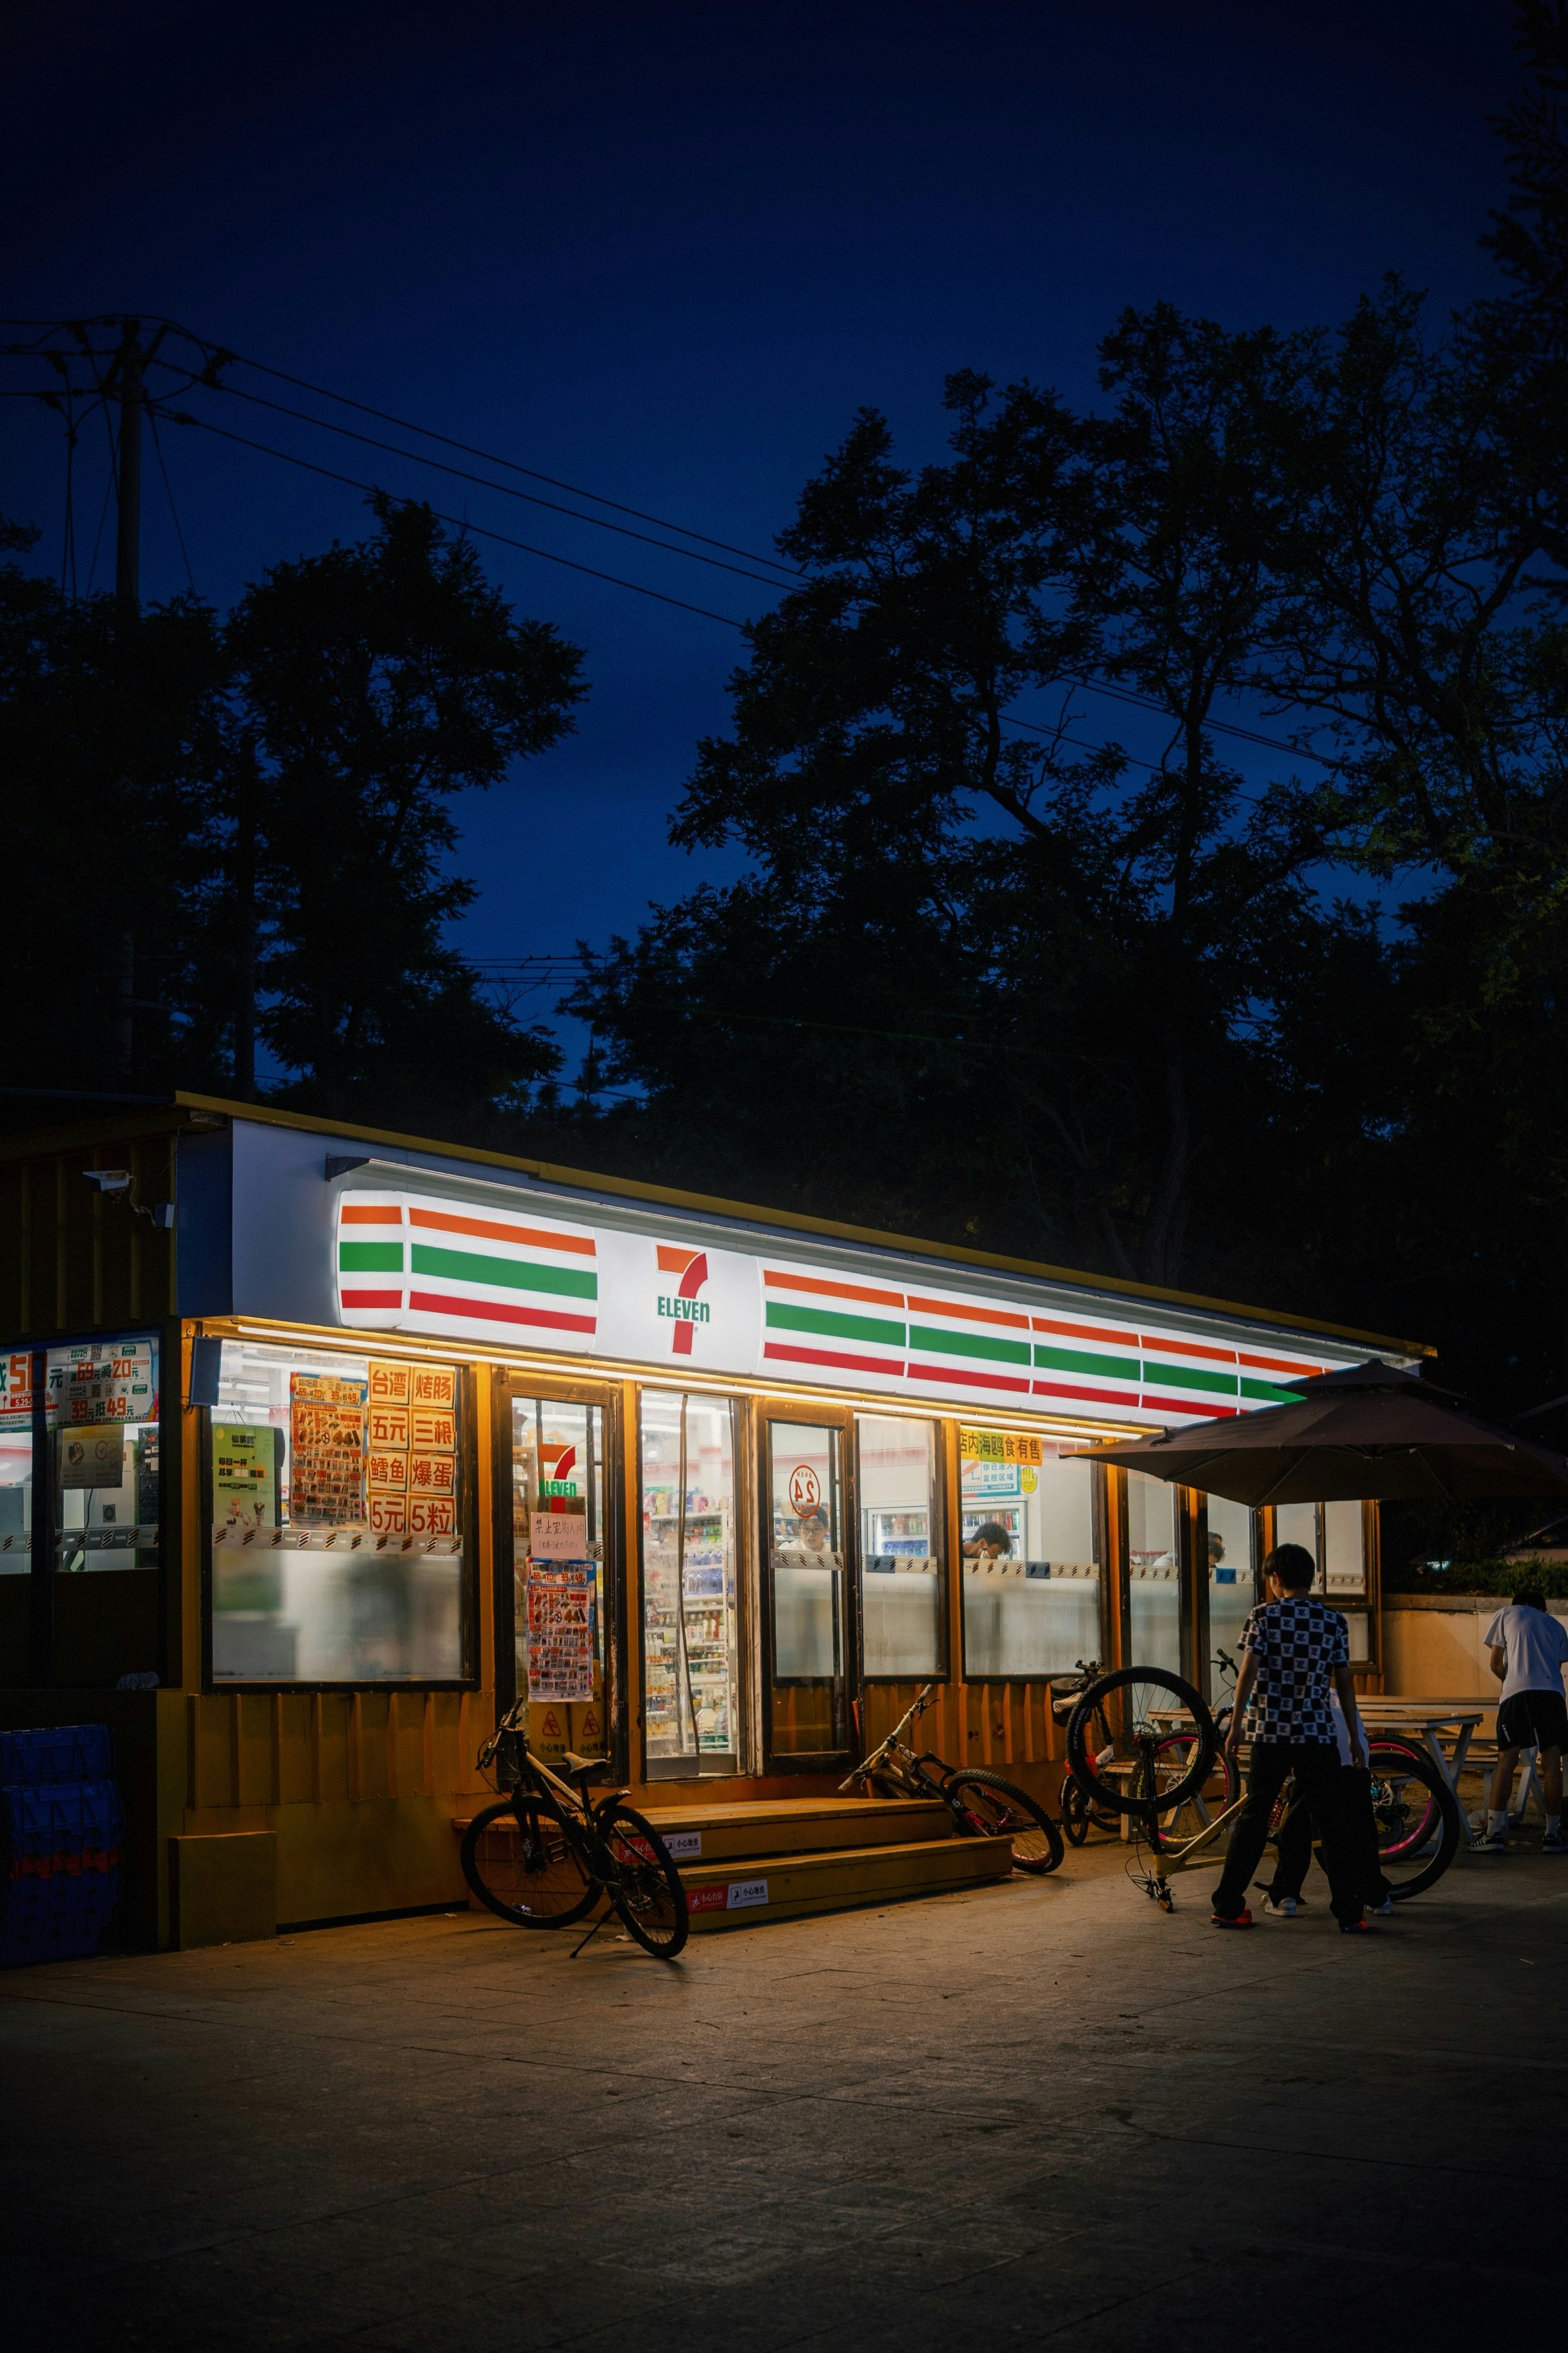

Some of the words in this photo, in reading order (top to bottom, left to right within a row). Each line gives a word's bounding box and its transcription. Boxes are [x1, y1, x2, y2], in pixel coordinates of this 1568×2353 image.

[656, 1245, 708, 1355] 7
[372, 1370, 407, 1397] 台湾
[415, 1374, 451, 1401] 烤肠
[71, 1396, 134, 1420] 39元抵49元
[373, 1415, 406, 1442] 五元
[415, 1420, 452, 1444] 三根
[960, 1431, 1040, 1460] 店内海鸥食有售
[219, 1457, 247, 1467] 每日一杯
[370, 1455, 405, 1484] 鳕鱼
[412, 1459, 452, 1488] 爆蛋
[983, 1473, 1013, 1482] 监控区域
[372, 1501, 404, 1533] 5元
[411, 1502, 452, 1535] 5粒
[535, 1517, 584, 1538] 禁止宠物入内
[540, 1742, 566, 1753] 小心地滑
[677, 1838, 698, 1847] 小心地滑
[701, 1891, 723, 1903] 小心台阶
[743, 1885, 764, 1896] 小心地滑
